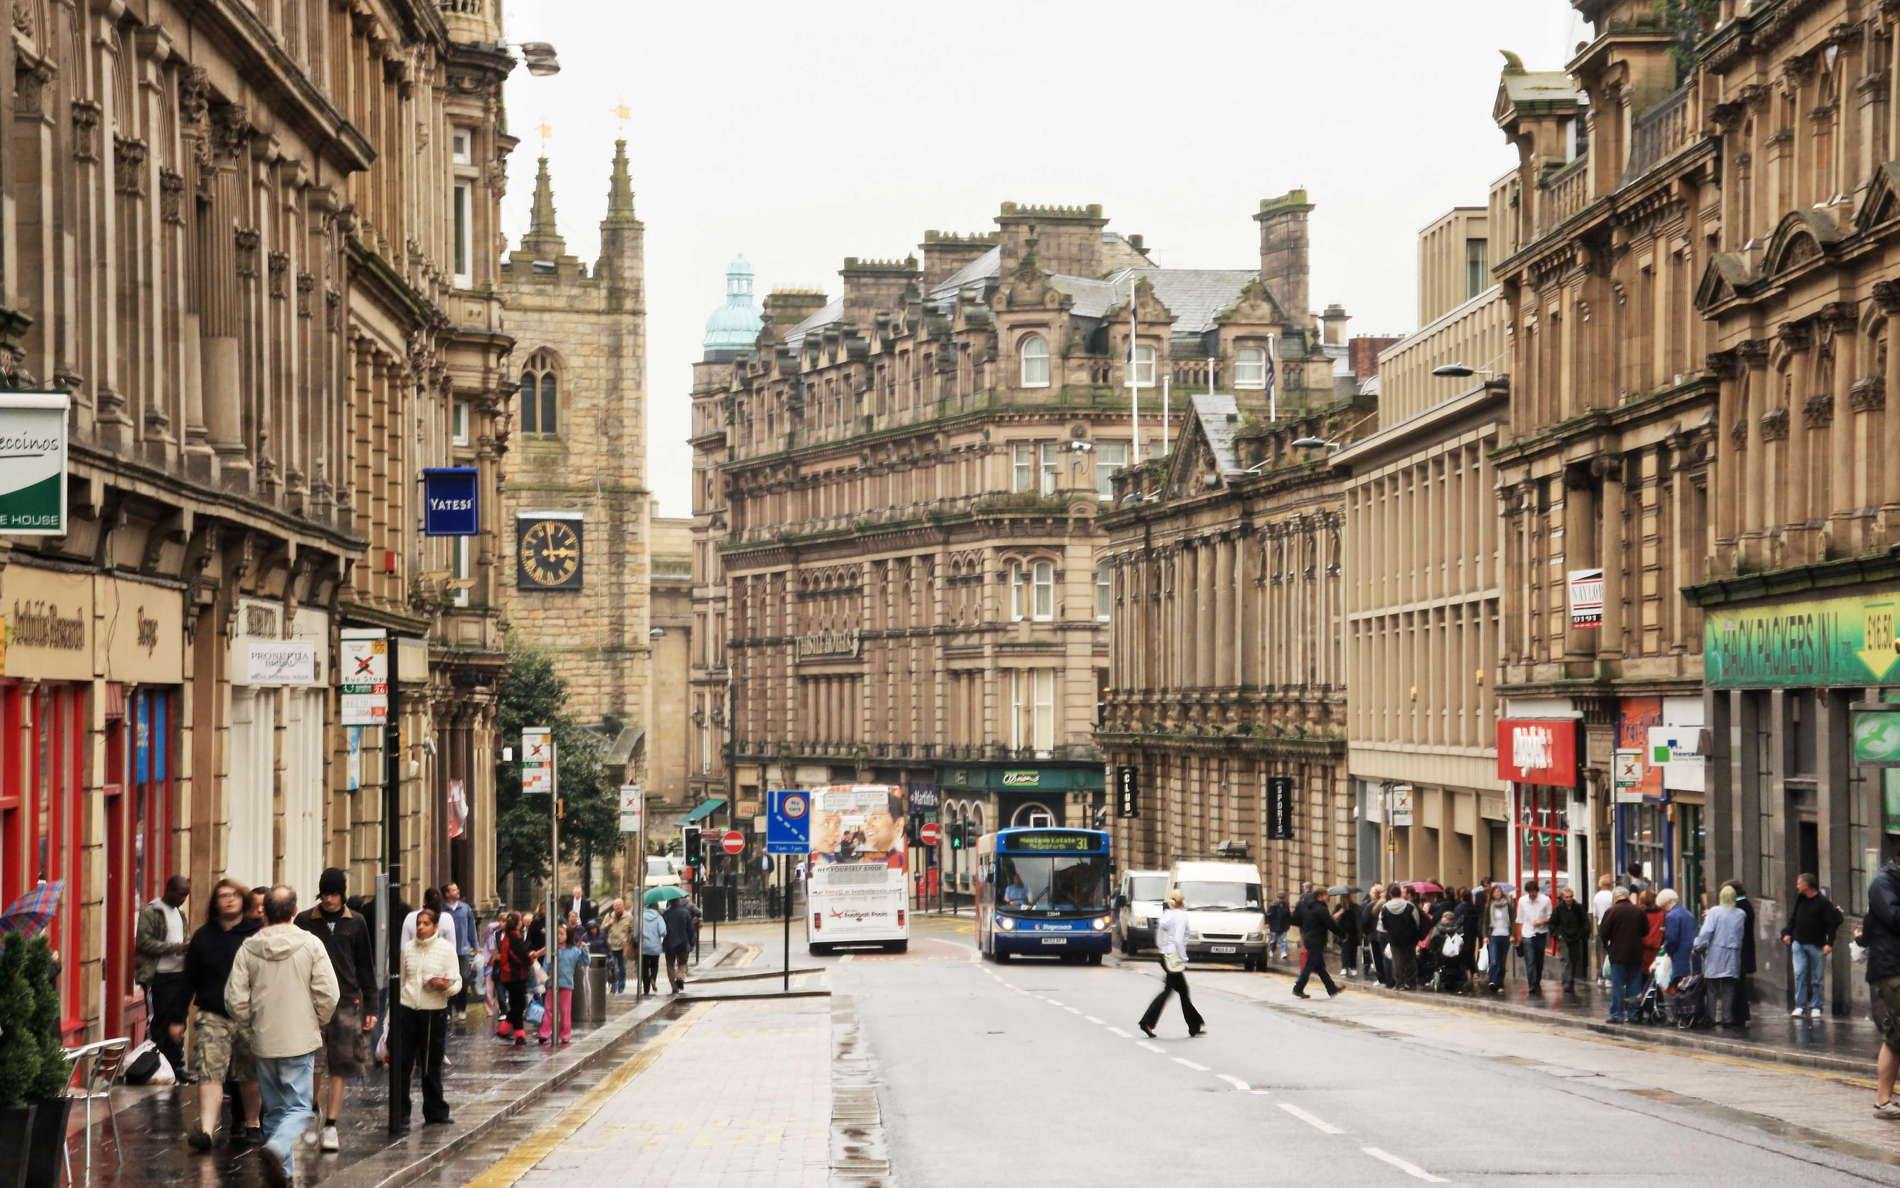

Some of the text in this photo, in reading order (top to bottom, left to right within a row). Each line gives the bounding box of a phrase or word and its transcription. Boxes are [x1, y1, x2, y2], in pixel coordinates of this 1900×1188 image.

[12, 514, 59, 525] HOUSE
[1574, 615, 1597, 623] 0191
[1868, 614, 1892, 650] £16.50
[364, 676, 384, 684] Stop
[1123, 773, 1131, 812] CLUB
[1076, 838, 1088, 850] 31
